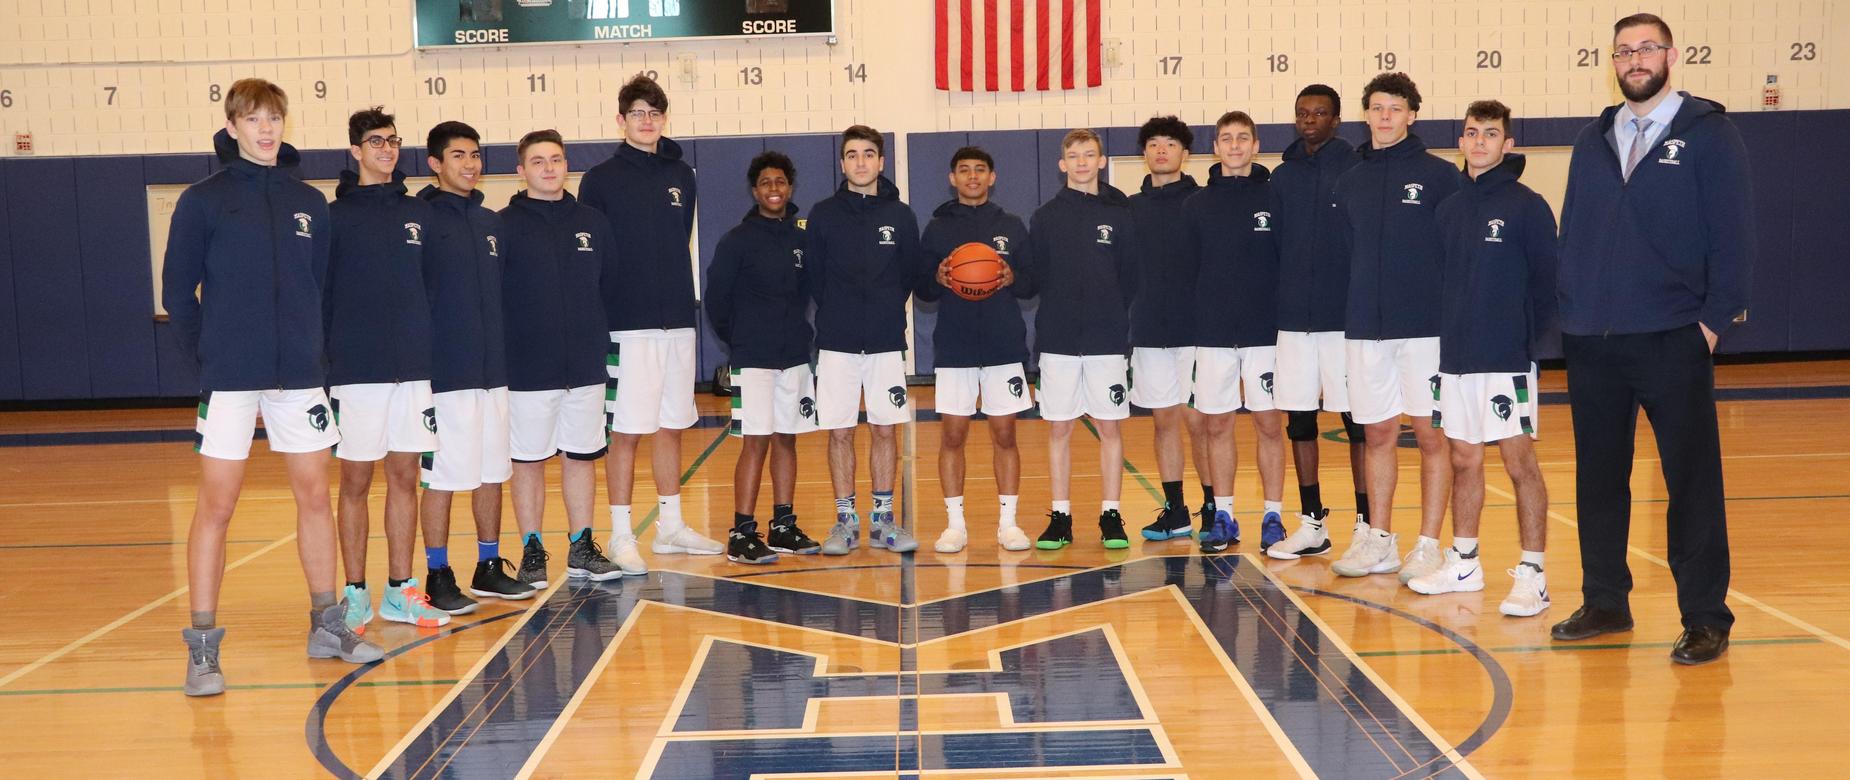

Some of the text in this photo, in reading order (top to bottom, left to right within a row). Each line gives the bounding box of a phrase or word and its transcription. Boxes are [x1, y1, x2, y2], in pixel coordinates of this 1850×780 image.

[594, 24, 652, 39] MATCH
[742, 19, 797, 34] SCORE
[455, 29, 509, 44] SCORE
[1476, 50, 1502, 69] 20
[1577, 48, 1599, 67] 21
[1685, 46, 1712, 65] 22
[1790, 42, 1816, 61] 23
[1159, 56, 1183, 75] 17
[1266, 54, 1289, 73] 18
[1374, 52, 1397, 71] 19
[527, 73, 546, 92] 11
[740, 67, 763, 85] 13
[844, 63, 868, 83] 14
[103, 86, 117, 106] 7
[209, 84, 221, 102] 8
[314, 80, 327, 99] 9
[424, 77, 447, 96] 10
[0, 89, 13, 108] 6
